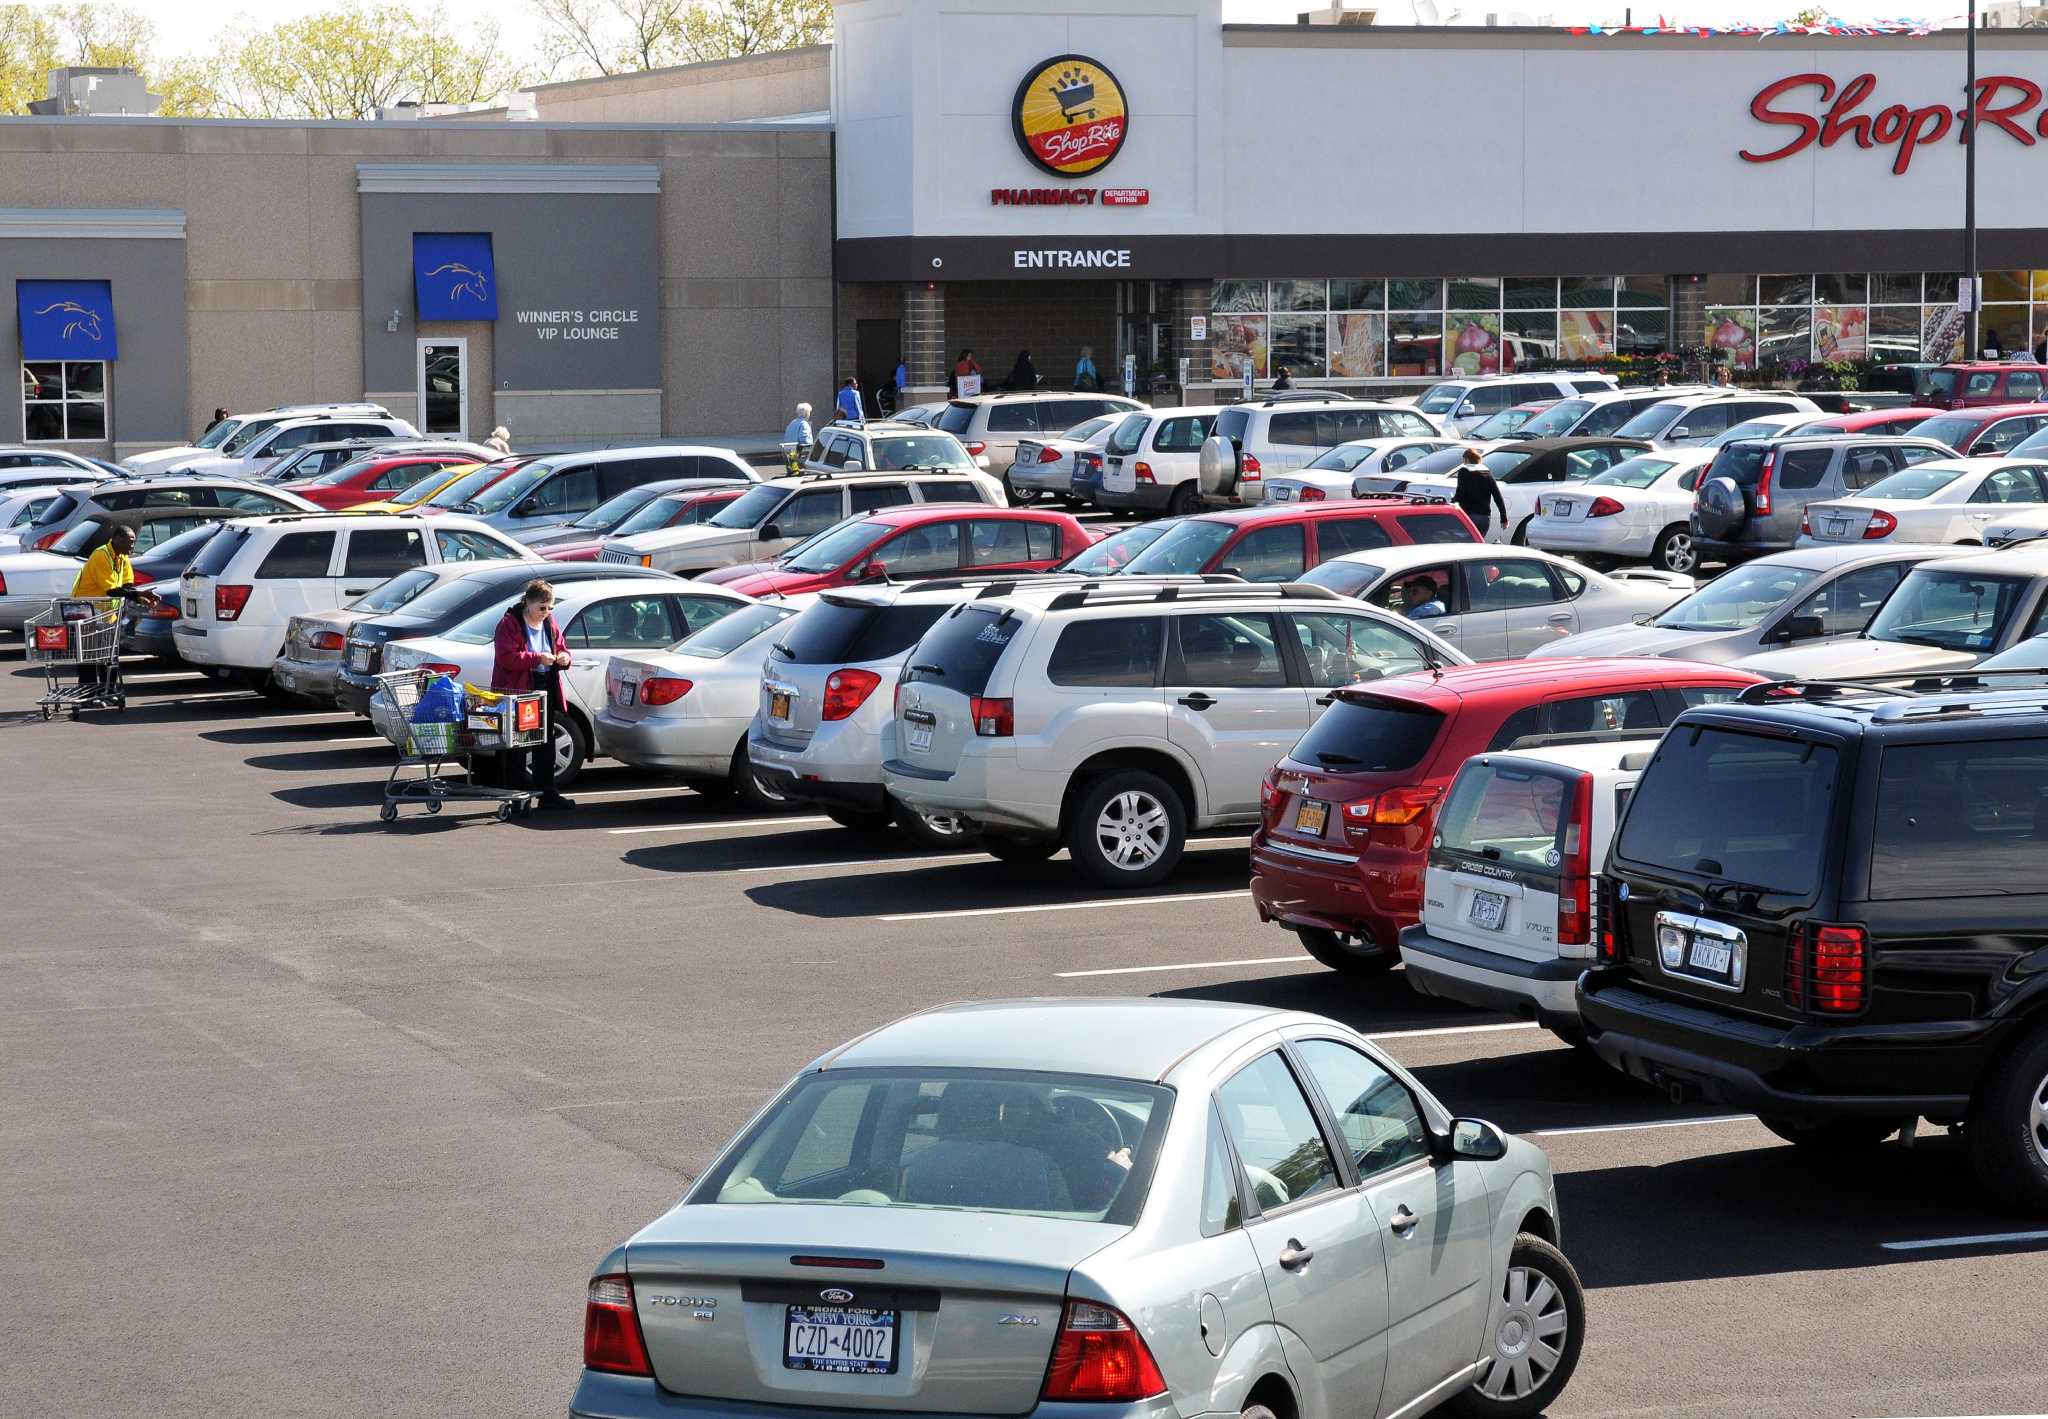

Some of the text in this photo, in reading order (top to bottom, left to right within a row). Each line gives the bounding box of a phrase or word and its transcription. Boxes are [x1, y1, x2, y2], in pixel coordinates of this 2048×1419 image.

[1044, 121, 1121, 161] ShopRite
[991, 188, 1098, 206] PHARMACY
[1104, 189, 1146, 197] DEPARTMENT
[1014, 249, 1131, 268] ENTRANCE
[516, 310, 639, 323] WINNER'S CIRCLE
[537, 327, 619, 340] VIP LOUNGE
[1461, 861, 1516, 880] CROSS COUNTRY
[650, 1295, 718, 1308] FOCUS
[827, 1291, 846, 1301] Ford
[806, 1306, 844, 1314] BRONX
[814, 1312, 871, 1326] NEW YORK
[826, 1359, 848, 1367] EMPIRE
[849, 1360, 868, 1368] STATE
